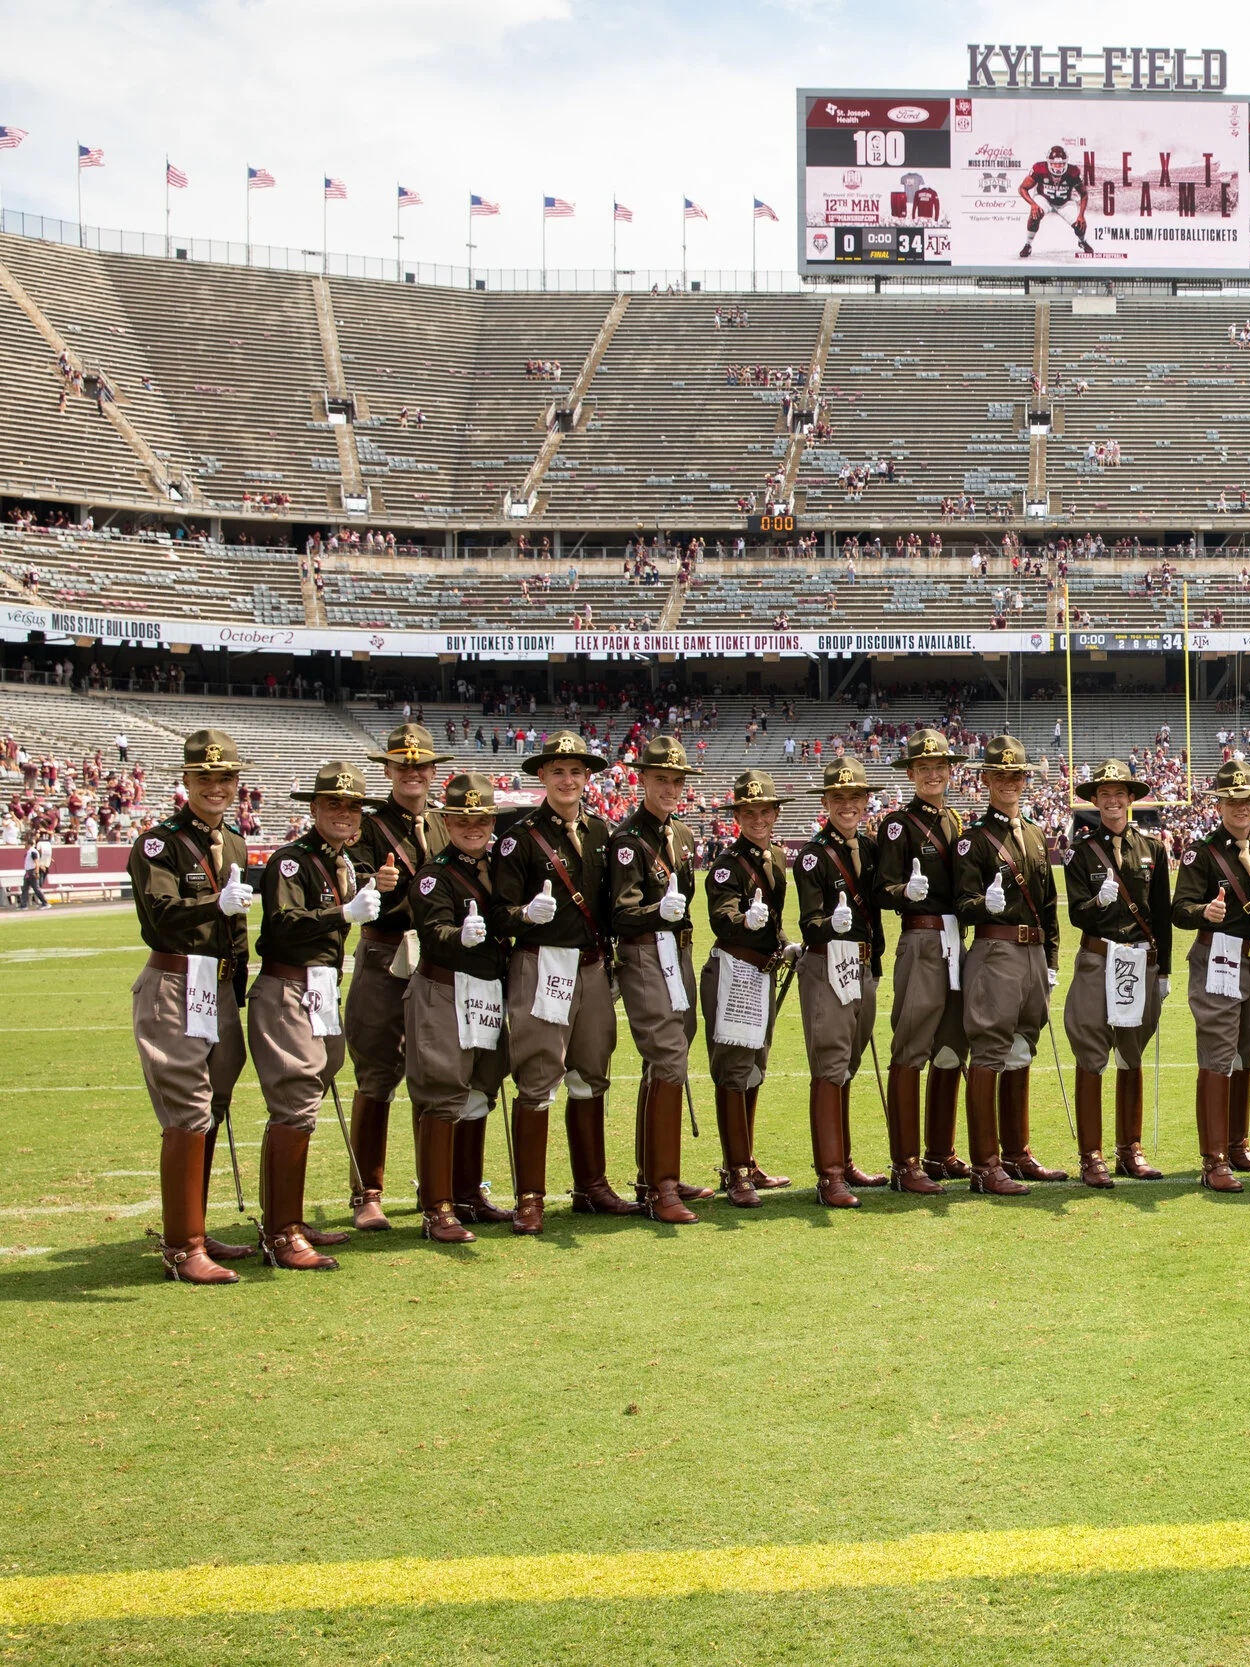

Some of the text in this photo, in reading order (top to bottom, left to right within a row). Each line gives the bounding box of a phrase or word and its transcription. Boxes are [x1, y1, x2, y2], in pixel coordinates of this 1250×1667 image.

[968, 44, 1228, 93] KYLE FIELD
[896, 109, 920, 120] Ford
[975, 144, 1014, 160] Aggies
[1084, 152, 1213, 187] NEXT
[1044, 190, 1068, 200] 55
[1103, 181, 1230, 217] GAME
[825, 200, 879, 212] 12TH MAN
[868, 234, 892, 244] 0:00
[1094, 228, 1237, 242] 12THMAN.COM/FOOTBALLTICKETS
[844, 234, 854, 252] 0
[899, 235, 922, 253] 34
[762, 516, 793, 530] 0:00
[7, 610, 161, 639] versus MISS STATE BULLDOGS
[220, 628, 294, 644] October 2
[447, 635, 975, 650] BUY TICKETS TODAY! FLEX PACK & SINGLE GAME TICKET OPTIONS. GROUP DISCOUNTS AVAILABLE.
[1080, 635, 1105, 645] 0:00
[1163, 634, 1182, 650] 34
[1118, 640, 1124, 649] 2
[1134, 640, 1139, 649] 8
[1146, 640, 1157, 648] 49
[547, 975, 573, 988] 12TH
[546, 987, 572, 1001] TEXA
[479, 1014, 501, 1029] MAN
